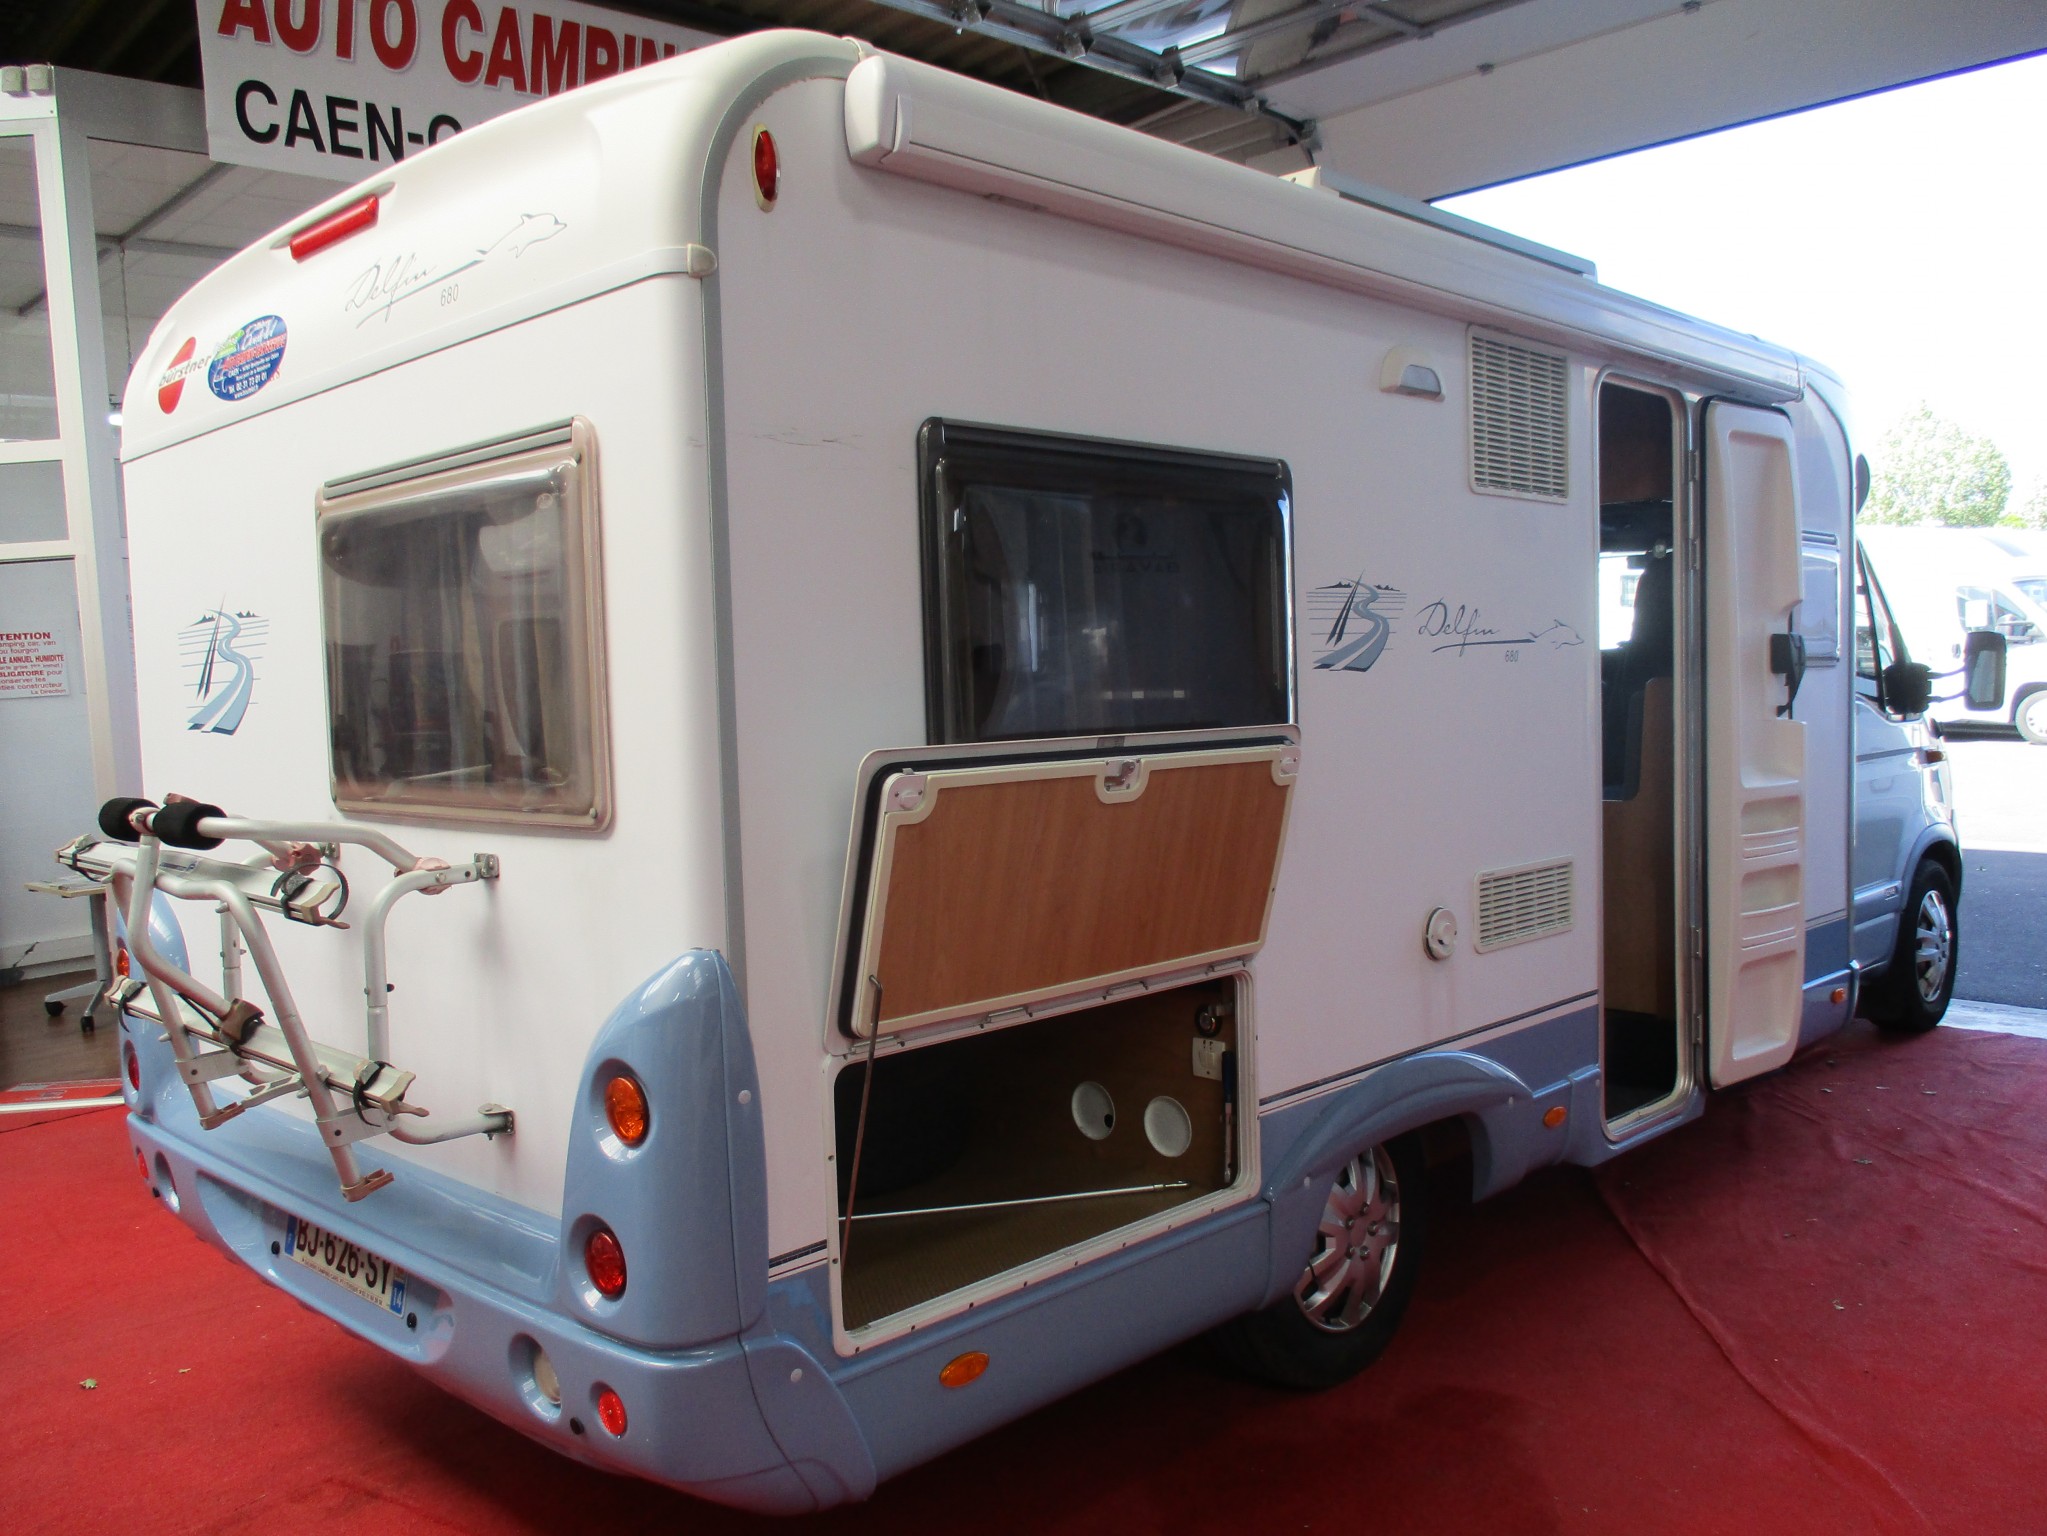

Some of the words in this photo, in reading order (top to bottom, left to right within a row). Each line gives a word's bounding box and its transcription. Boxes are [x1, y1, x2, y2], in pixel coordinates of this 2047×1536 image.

[217, 0, 417, 71] AUTO
[440, 283, 459, 307] 680
[159, 354, 212, 388] bürstner
[1414, 596, 1501, 658] Delfin
[1504, 649, 1519, 663] 680
